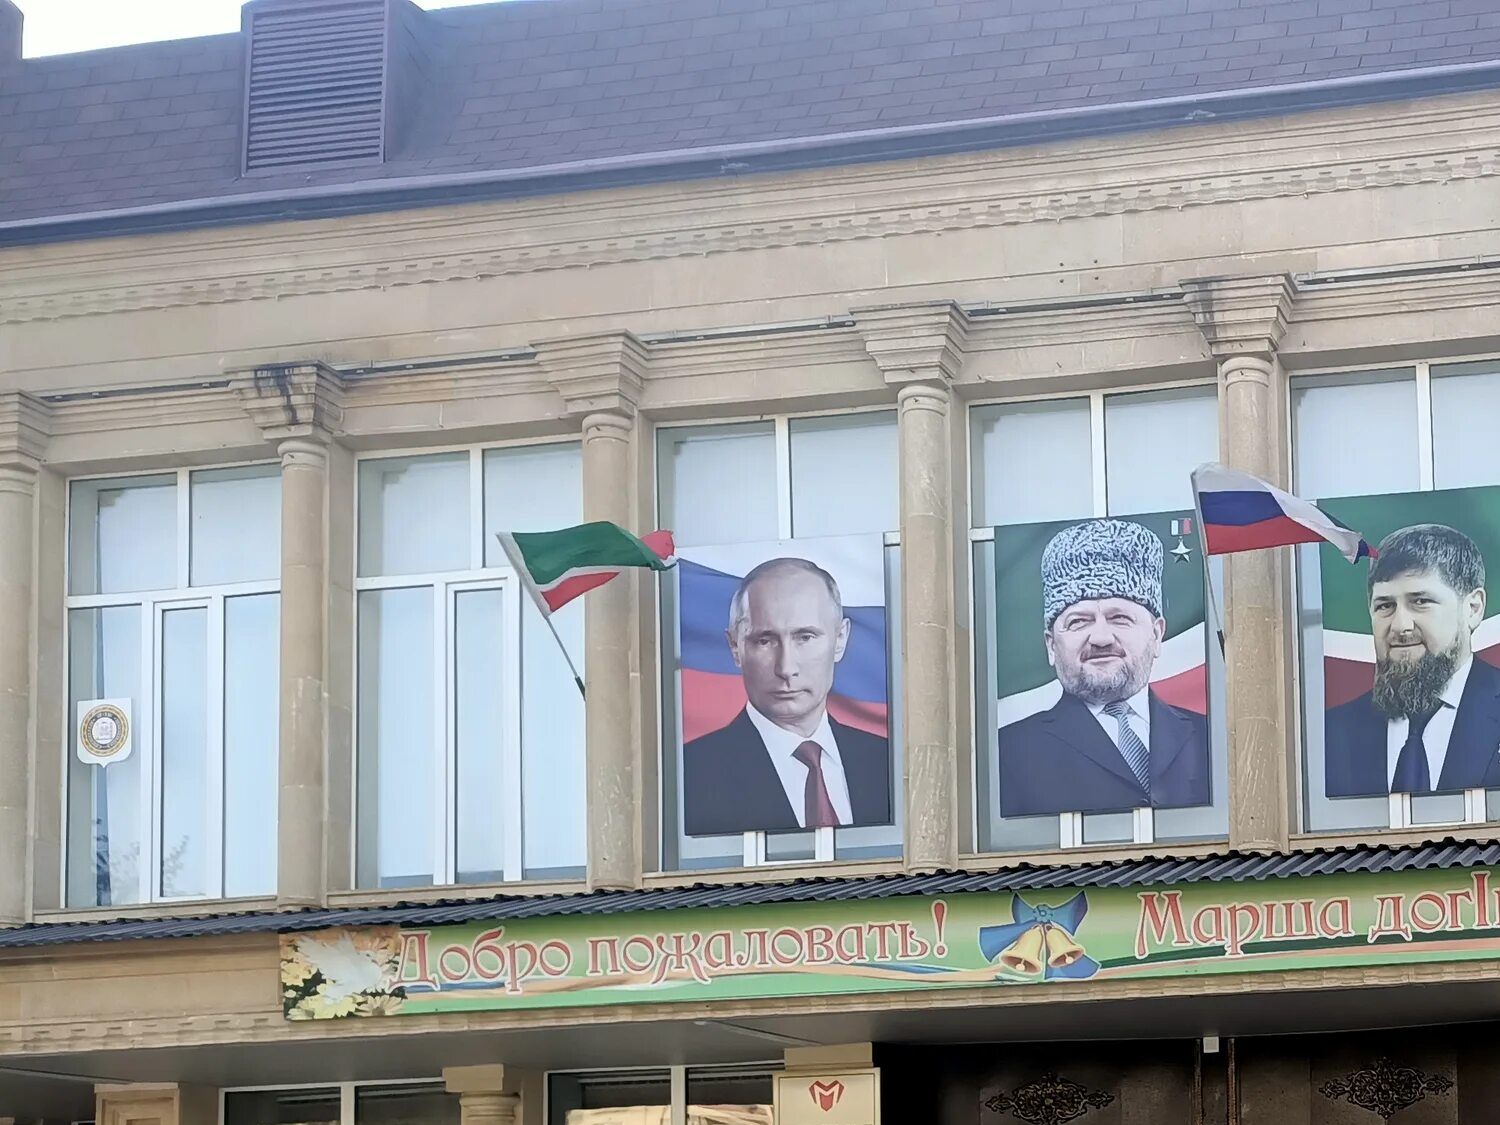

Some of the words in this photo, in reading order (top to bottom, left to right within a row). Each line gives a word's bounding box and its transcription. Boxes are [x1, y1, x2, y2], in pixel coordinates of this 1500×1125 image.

[390, 930, 573, 991] Добро
[587, 901, 948, 983] пожаловать!
[1135, 890, 1355, 956] Марша
